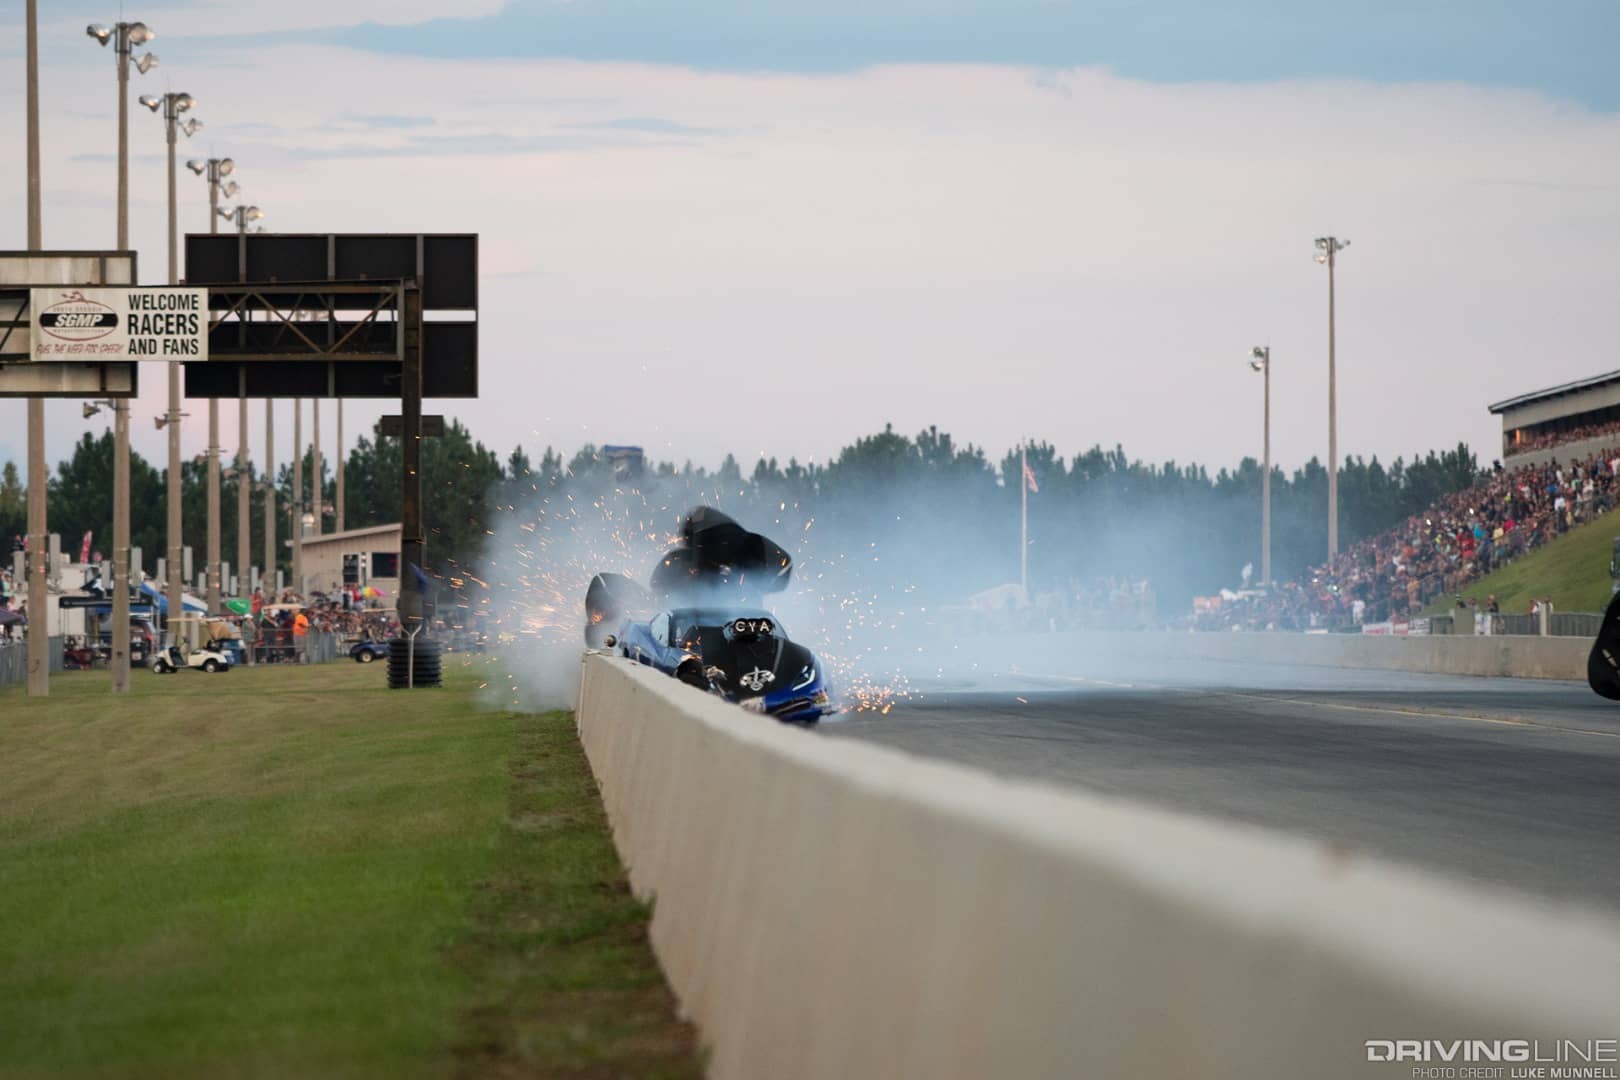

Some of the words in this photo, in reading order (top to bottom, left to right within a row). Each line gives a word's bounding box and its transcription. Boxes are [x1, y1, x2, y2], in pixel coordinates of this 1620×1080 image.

[128, 294, 199, 310] WELCOME
[54, 314, 103, 327] SGMP
[128, 313, 199, 335] RACERS
[128, 338, 157, 355] AND
[163, 338, 199, 355] FANS
